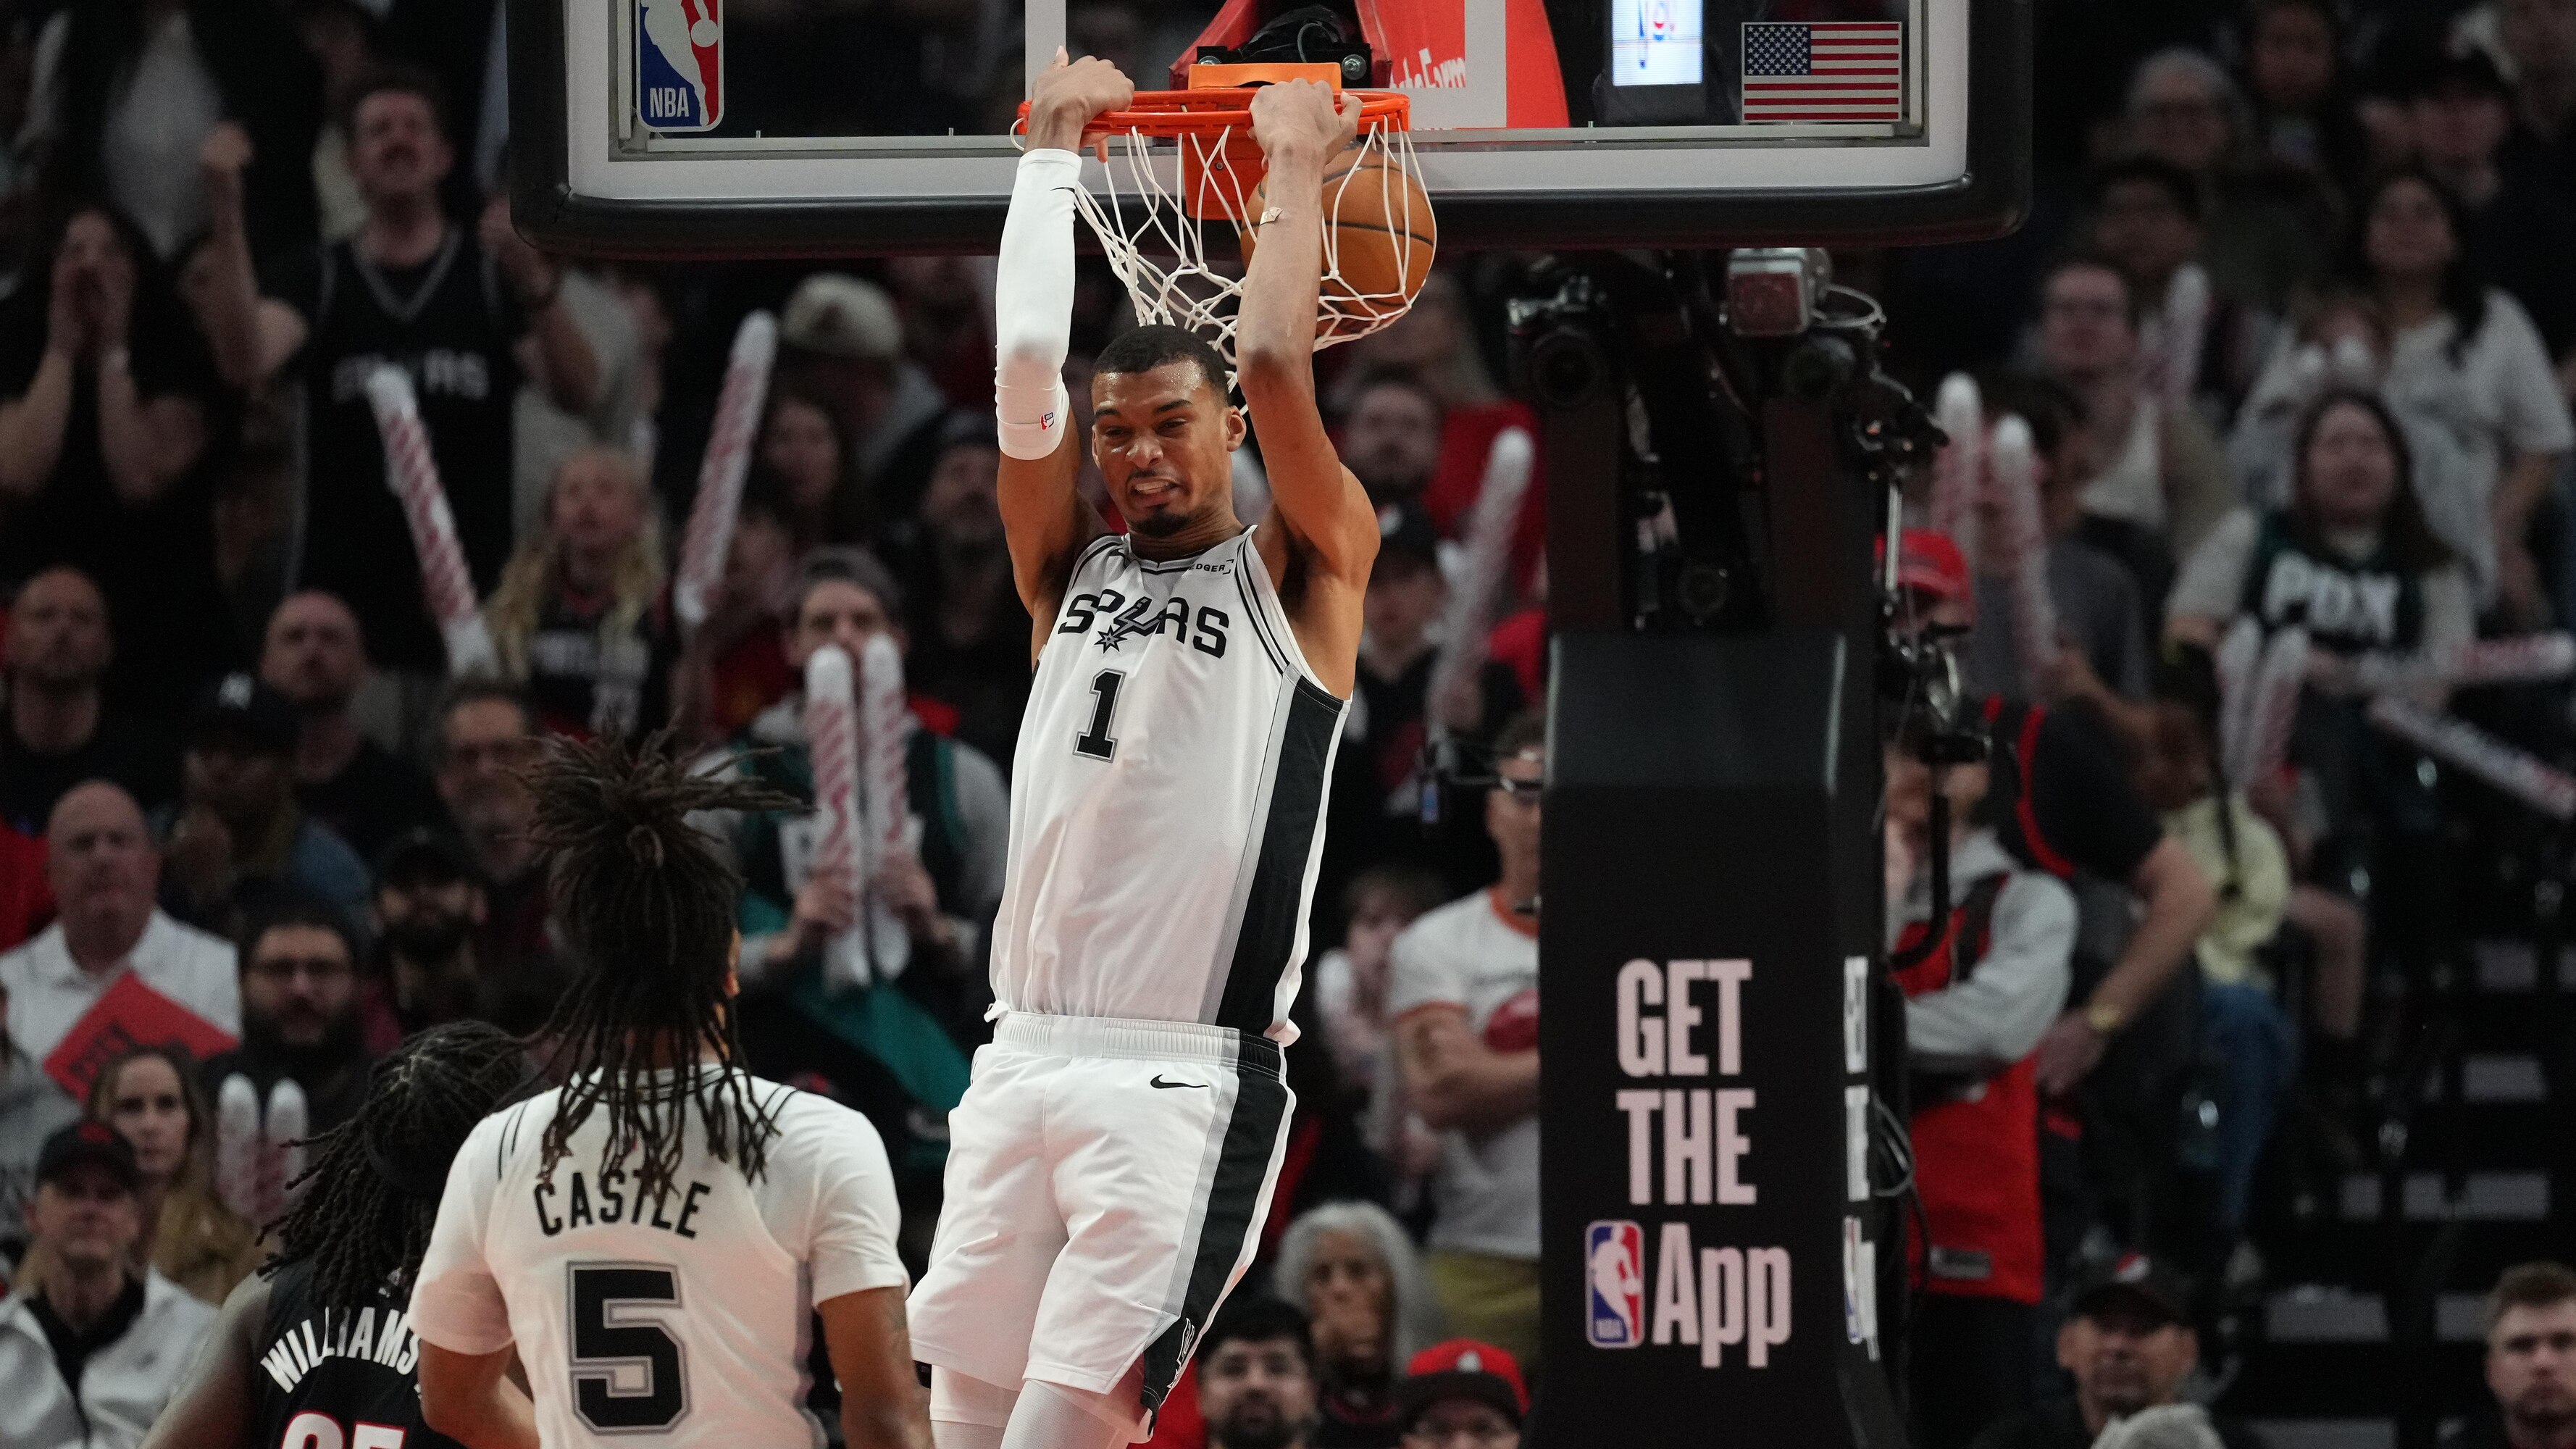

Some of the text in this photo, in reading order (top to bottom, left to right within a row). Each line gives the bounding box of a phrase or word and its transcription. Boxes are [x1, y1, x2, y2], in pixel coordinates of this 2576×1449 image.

[650, 87, 690, 118] NBA
[1057, 588, 1230, 659] SPURS
[1072, 667, 1127, 764] 1
[1616, 957, 1754, 1078] GET
[1615, 1088, 1758, 1206] THE
[533, 1171, 711, 1240] CASTLE
[565, 1260, 693, 1437] 5
[1650, 1221, 1792, 1369] App
